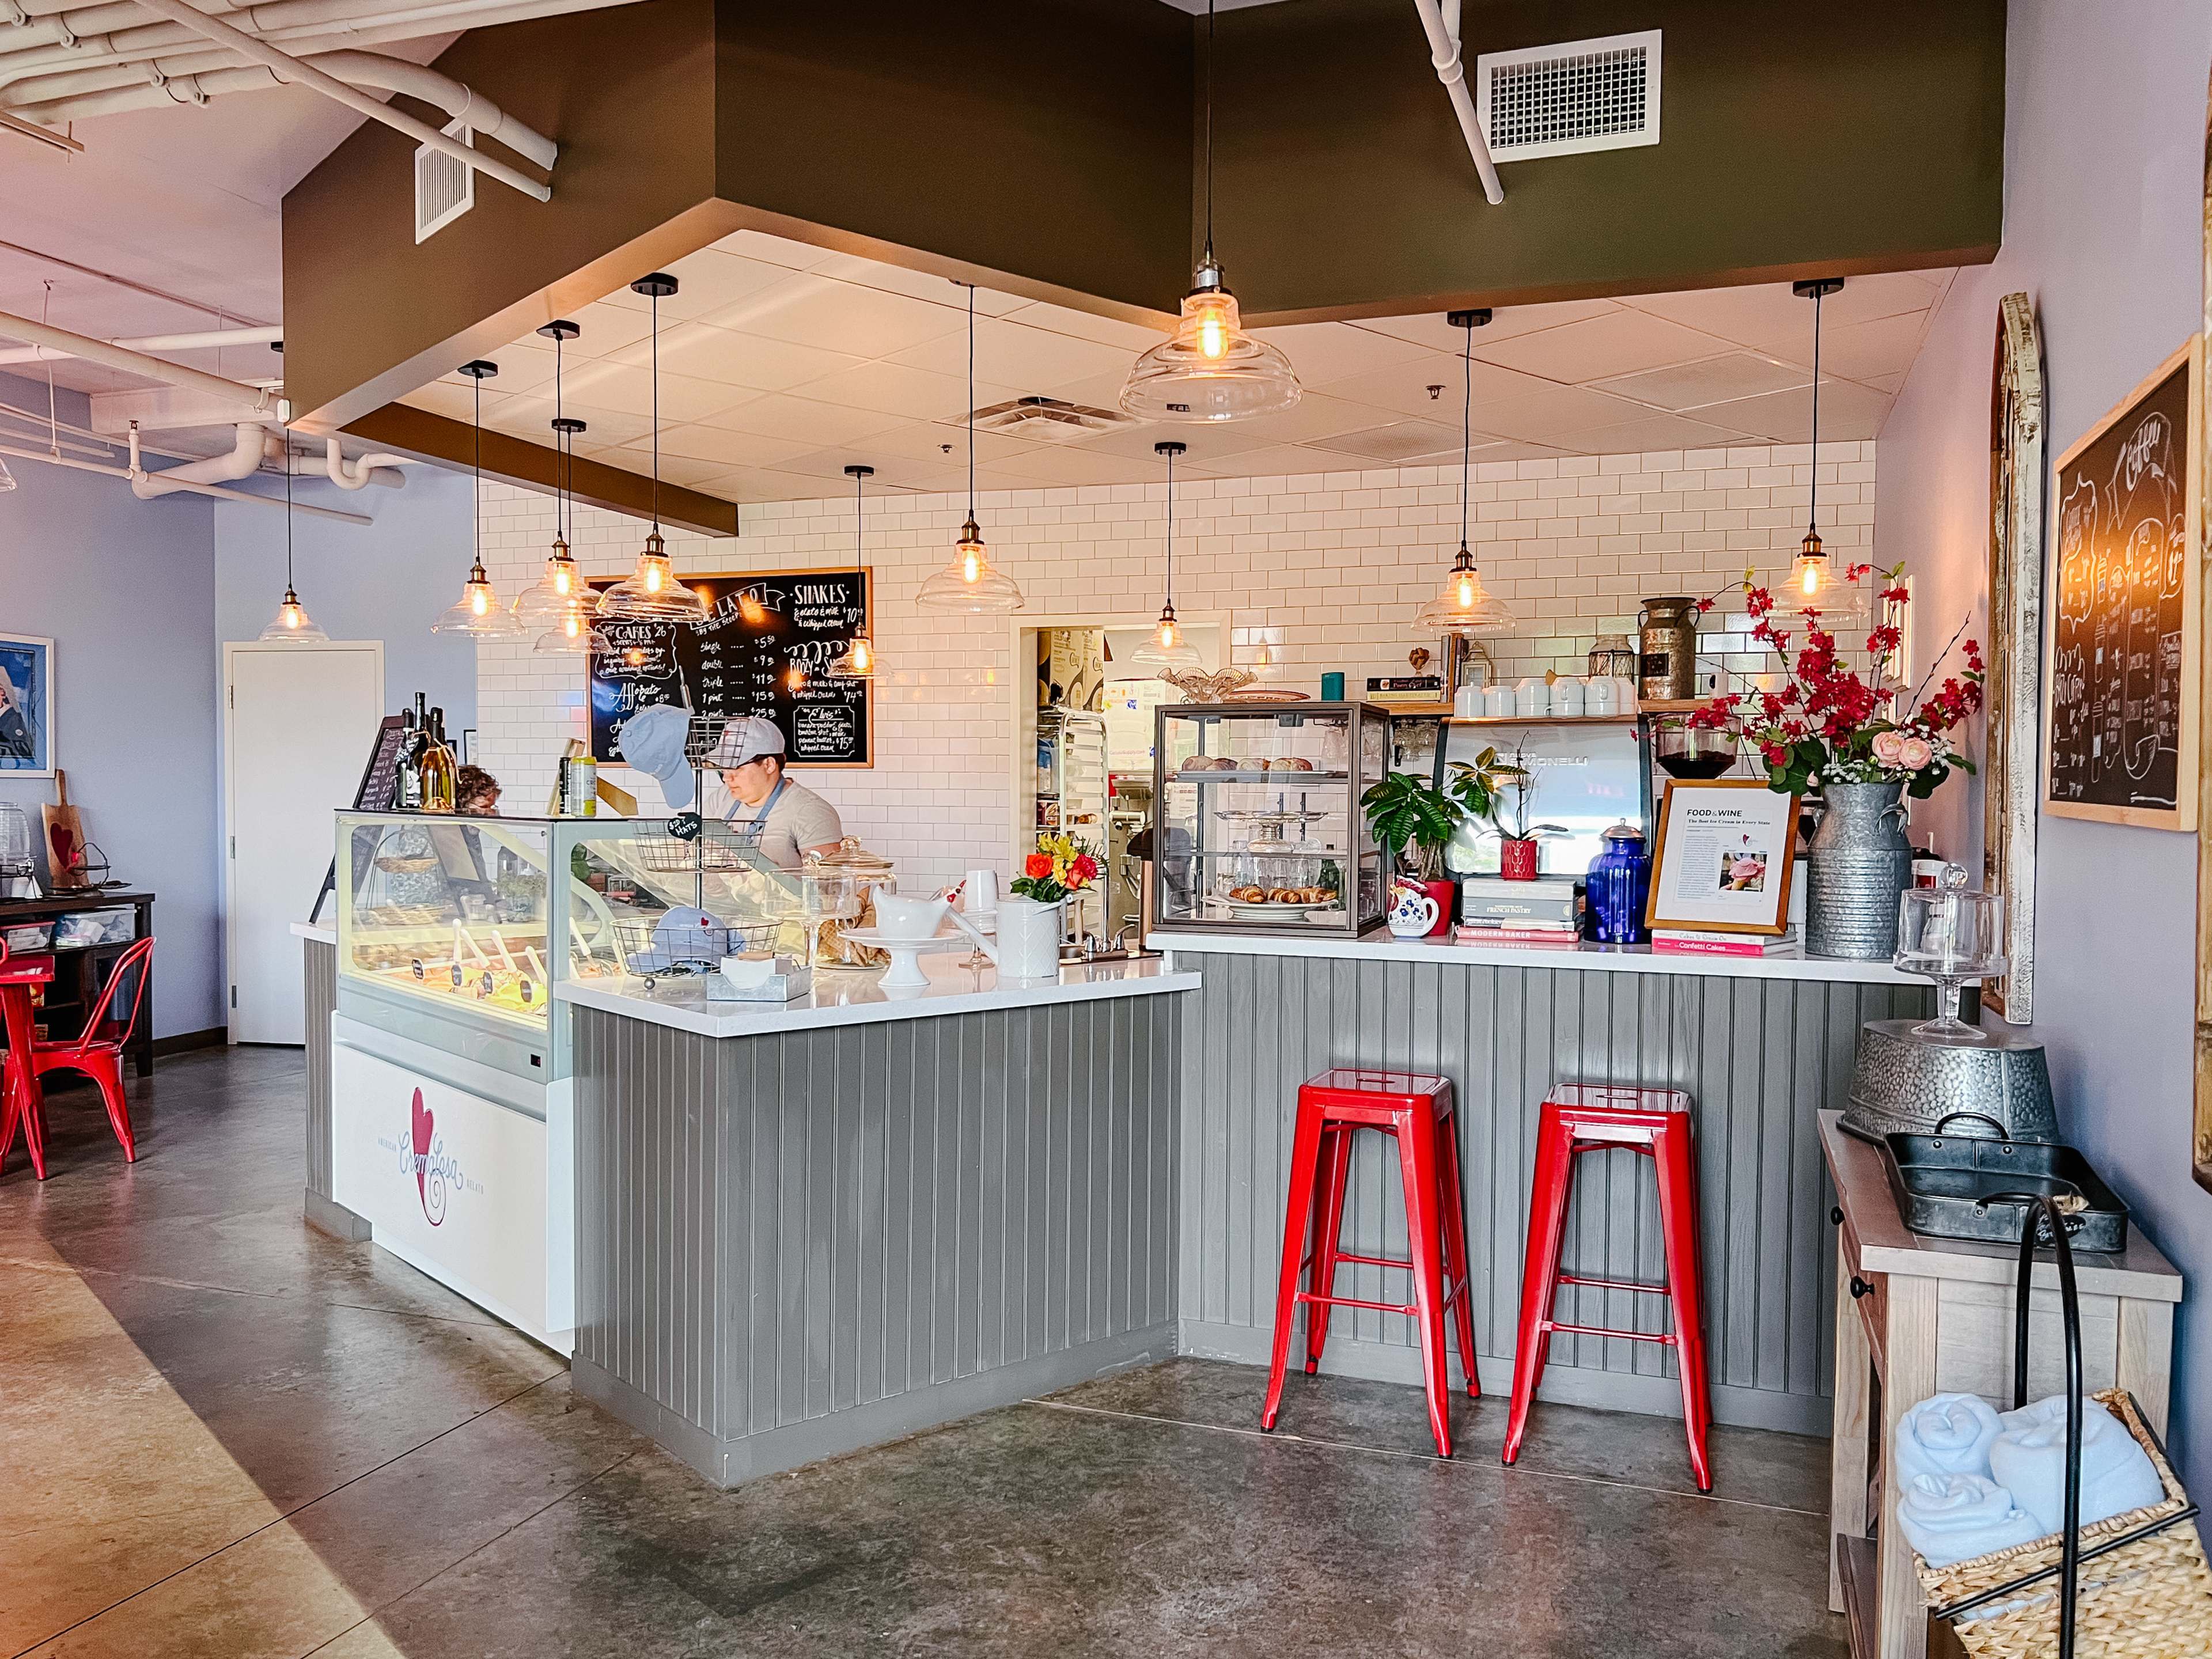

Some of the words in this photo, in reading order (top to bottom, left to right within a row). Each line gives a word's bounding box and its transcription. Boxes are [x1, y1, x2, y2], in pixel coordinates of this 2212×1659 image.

[2126, 419, 2160, 491] Coffee
[794, 584, 846, 604] SHAKES
[615, 626, 652, 639] CAKES
[654, 623, 666, 637] $26
[709, 621, 721, 632] THE
[675, 821, 698, 836] HATS
[1679, 942, 1705, 950] Confetti
[1706, 944, 1726, 952] Cakes
[378, 1137, 397, 1152] AMERICAN
